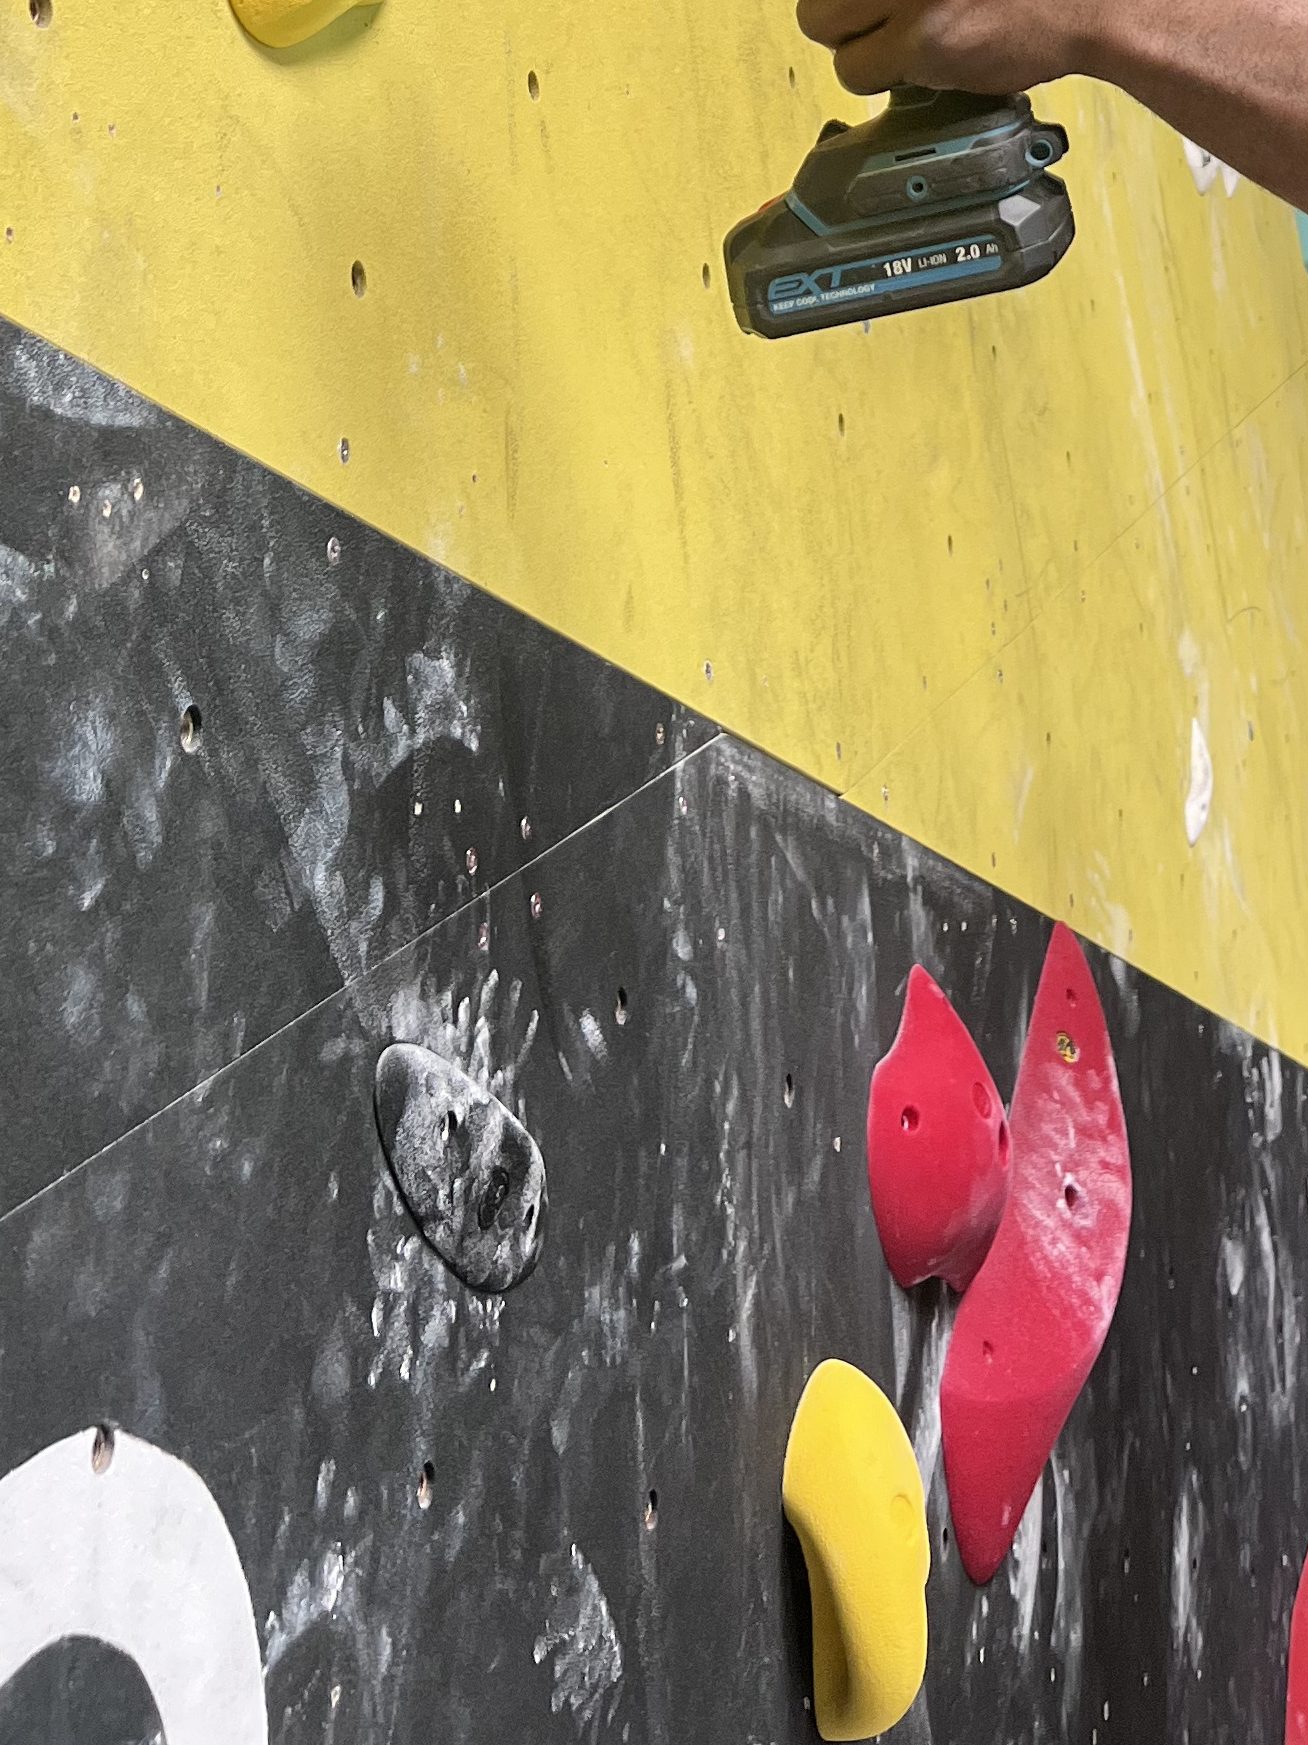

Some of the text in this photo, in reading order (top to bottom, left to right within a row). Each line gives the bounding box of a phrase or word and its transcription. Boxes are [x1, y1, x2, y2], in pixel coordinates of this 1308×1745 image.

[767, 264, 842, 302] EXT
[883, 257, 913, 277] 18V
[955, 243, 981, 263] 2.0
